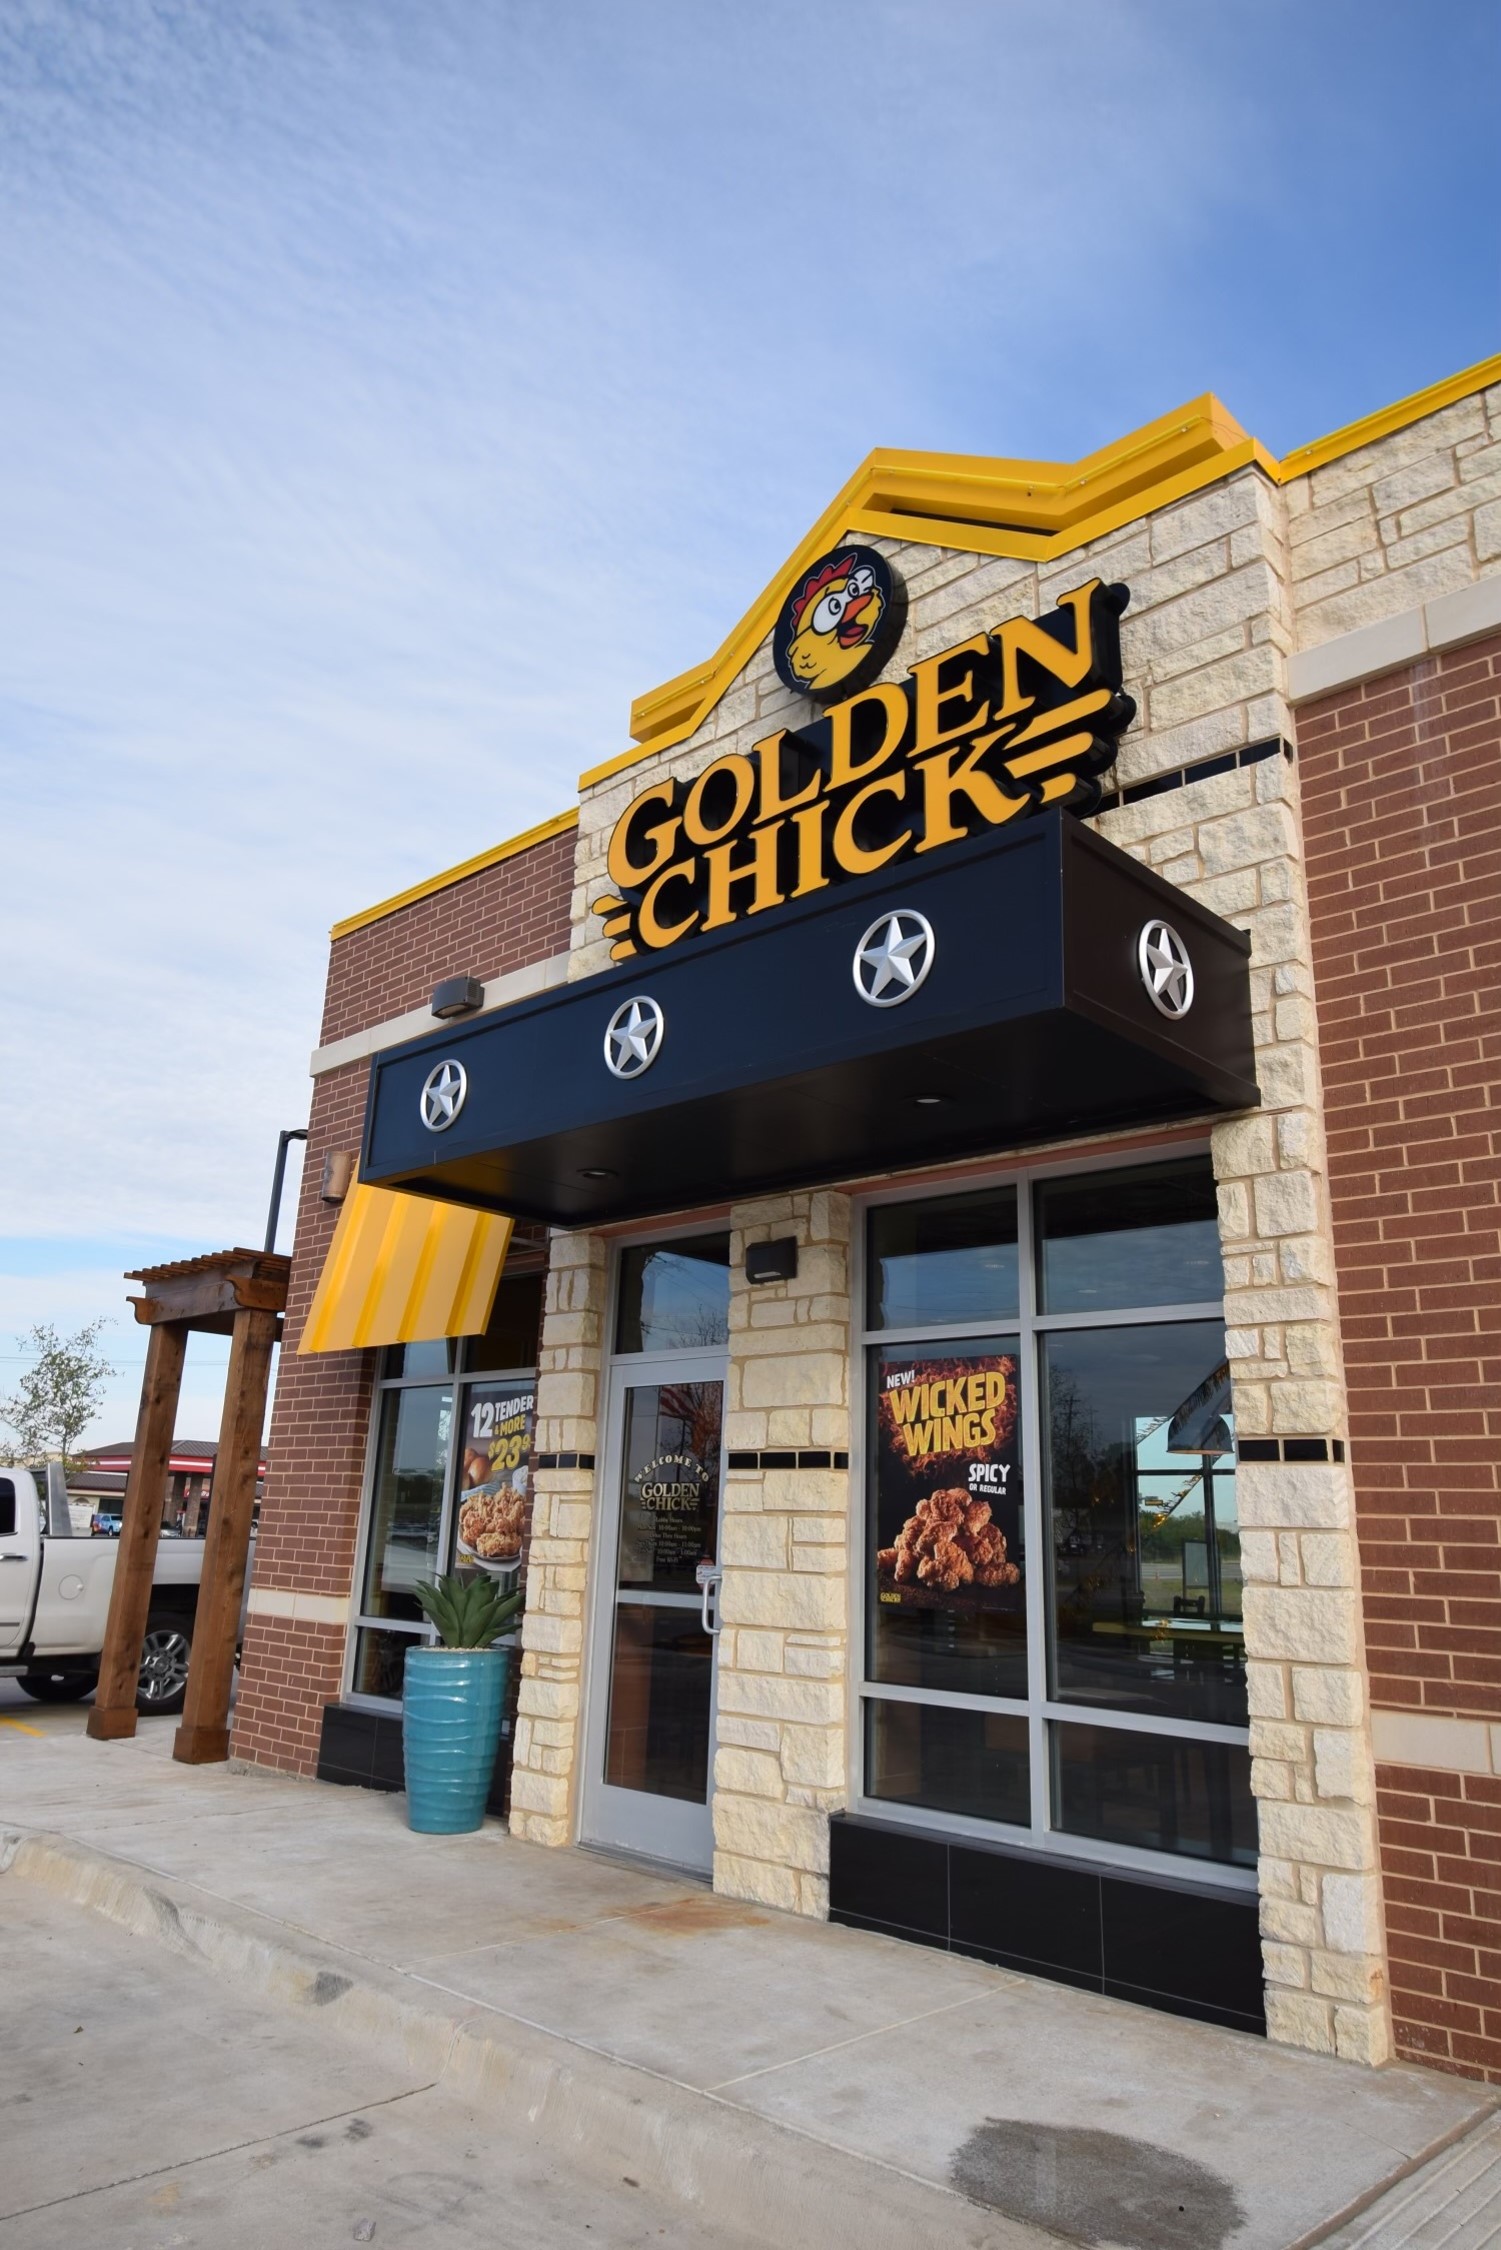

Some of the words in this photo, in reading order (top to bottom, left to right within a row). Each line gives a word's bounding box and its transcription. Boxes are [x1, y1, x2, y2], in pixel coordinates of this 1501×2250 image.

[606, 577, 1100, 889] GOLDEN
[637, 722, 1030, 949] CHICK
[886, 1370, 915, 1389] NEW!
[889, 1371, 1006, 1424] WICKED
[471, 1402, 495, 1438] 12
[500, 1414, 526, 1437] MORE
[902, 1408, 996, 1457] WINGS
[634, 1454, 693, 1483] WELCOME
[695, 1464, 709, 1482] TO
[968, 1463, 1011, 1483] SPICY
[641, 1482, 700, 1499] GOLDEN
[968, 1483, 978, 1492] OR
[979, 1483, 1007, 1496] REGULAR
[646, 1497, 691, 1511] CHICK
